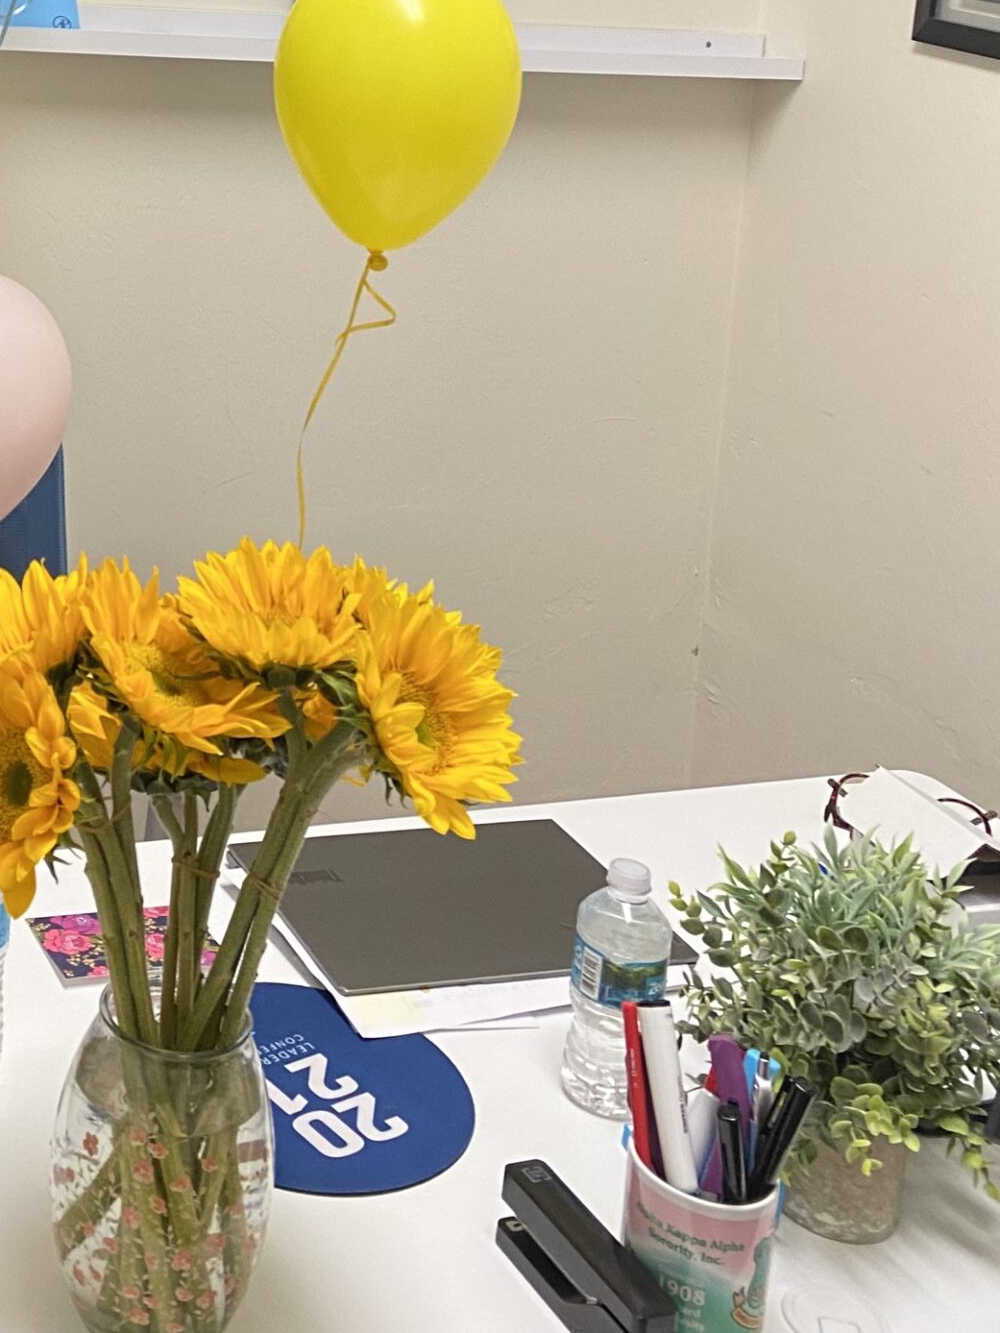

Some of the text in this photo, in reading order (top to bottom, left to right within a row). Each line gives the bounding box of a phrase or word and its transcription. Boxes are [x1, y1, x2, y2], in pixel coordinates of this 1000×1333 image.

[257, 1034, 305, 1056] CONFE
[265, 1052, 359, 1115] 21
[291, 1091, 409, 1158] 20
[665, 1222, 707, 1248] Kappa
[709, 1239, 745, 1253] Alpha
